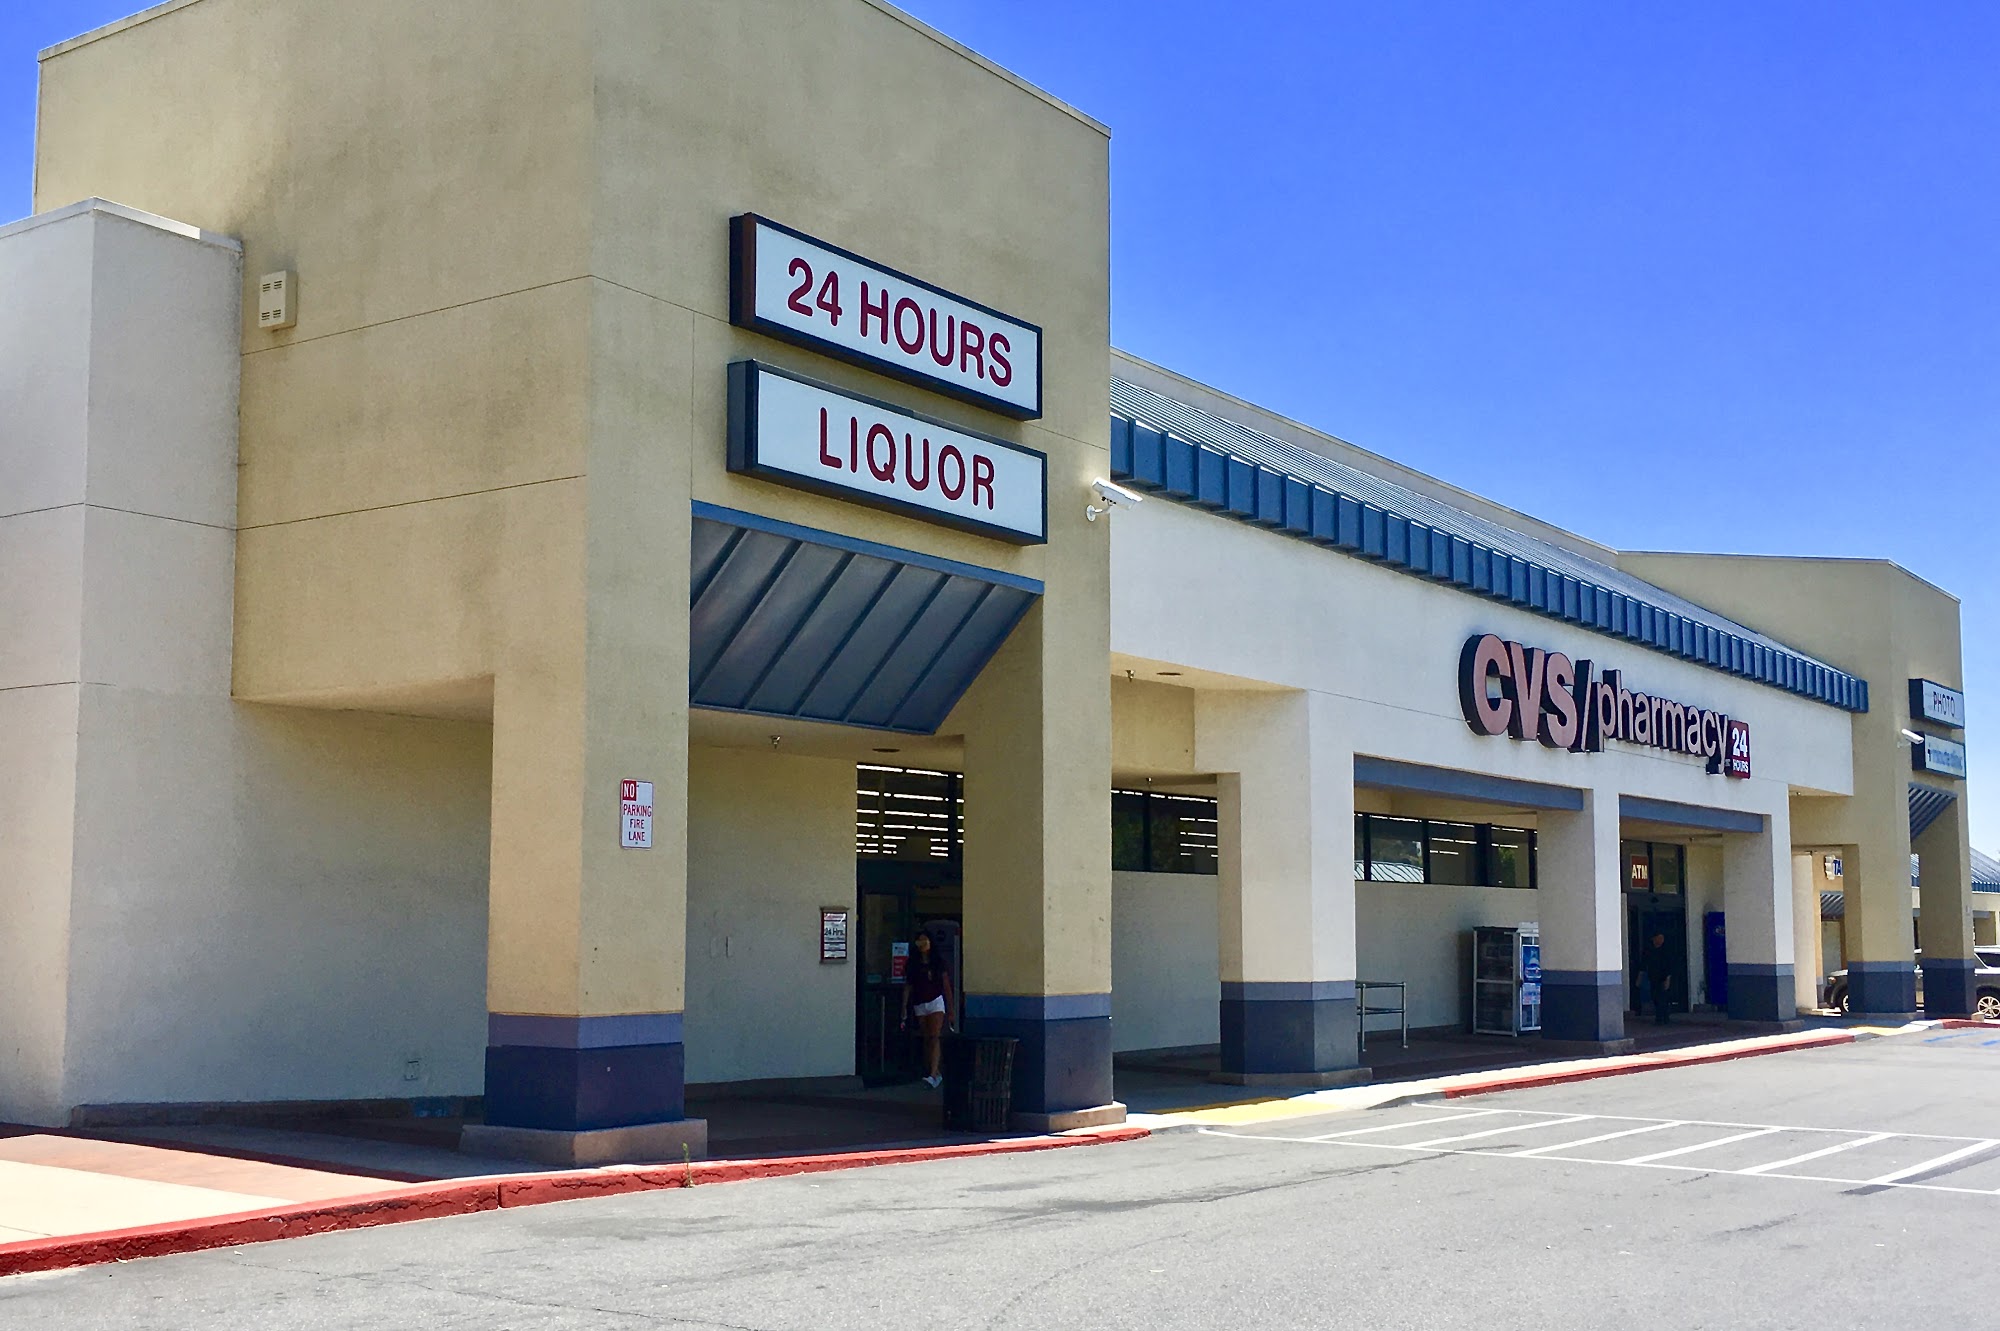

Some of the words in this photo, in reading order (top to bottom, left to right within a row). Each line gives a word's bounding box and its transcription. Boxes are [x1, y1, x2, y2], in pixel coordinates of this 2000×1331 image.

[787, 257, 843, 327] 24
[859, 280, 1013, 388] HOURS
[819, 406, 996, 511] LIQUOR
[1932, 691, 1956, 718] PHOTO
[1732, 727, 1748, 758] 24
[1732, 758, 1749, 773] HOURS
[623, 783, 635, 798] NO
[623, 803, 652, 817] PARKING
[629, 818, 645, 829] FIRE
[628, 831, 646, 842] LANE
[1631, 864, 1648, 880] ATM
